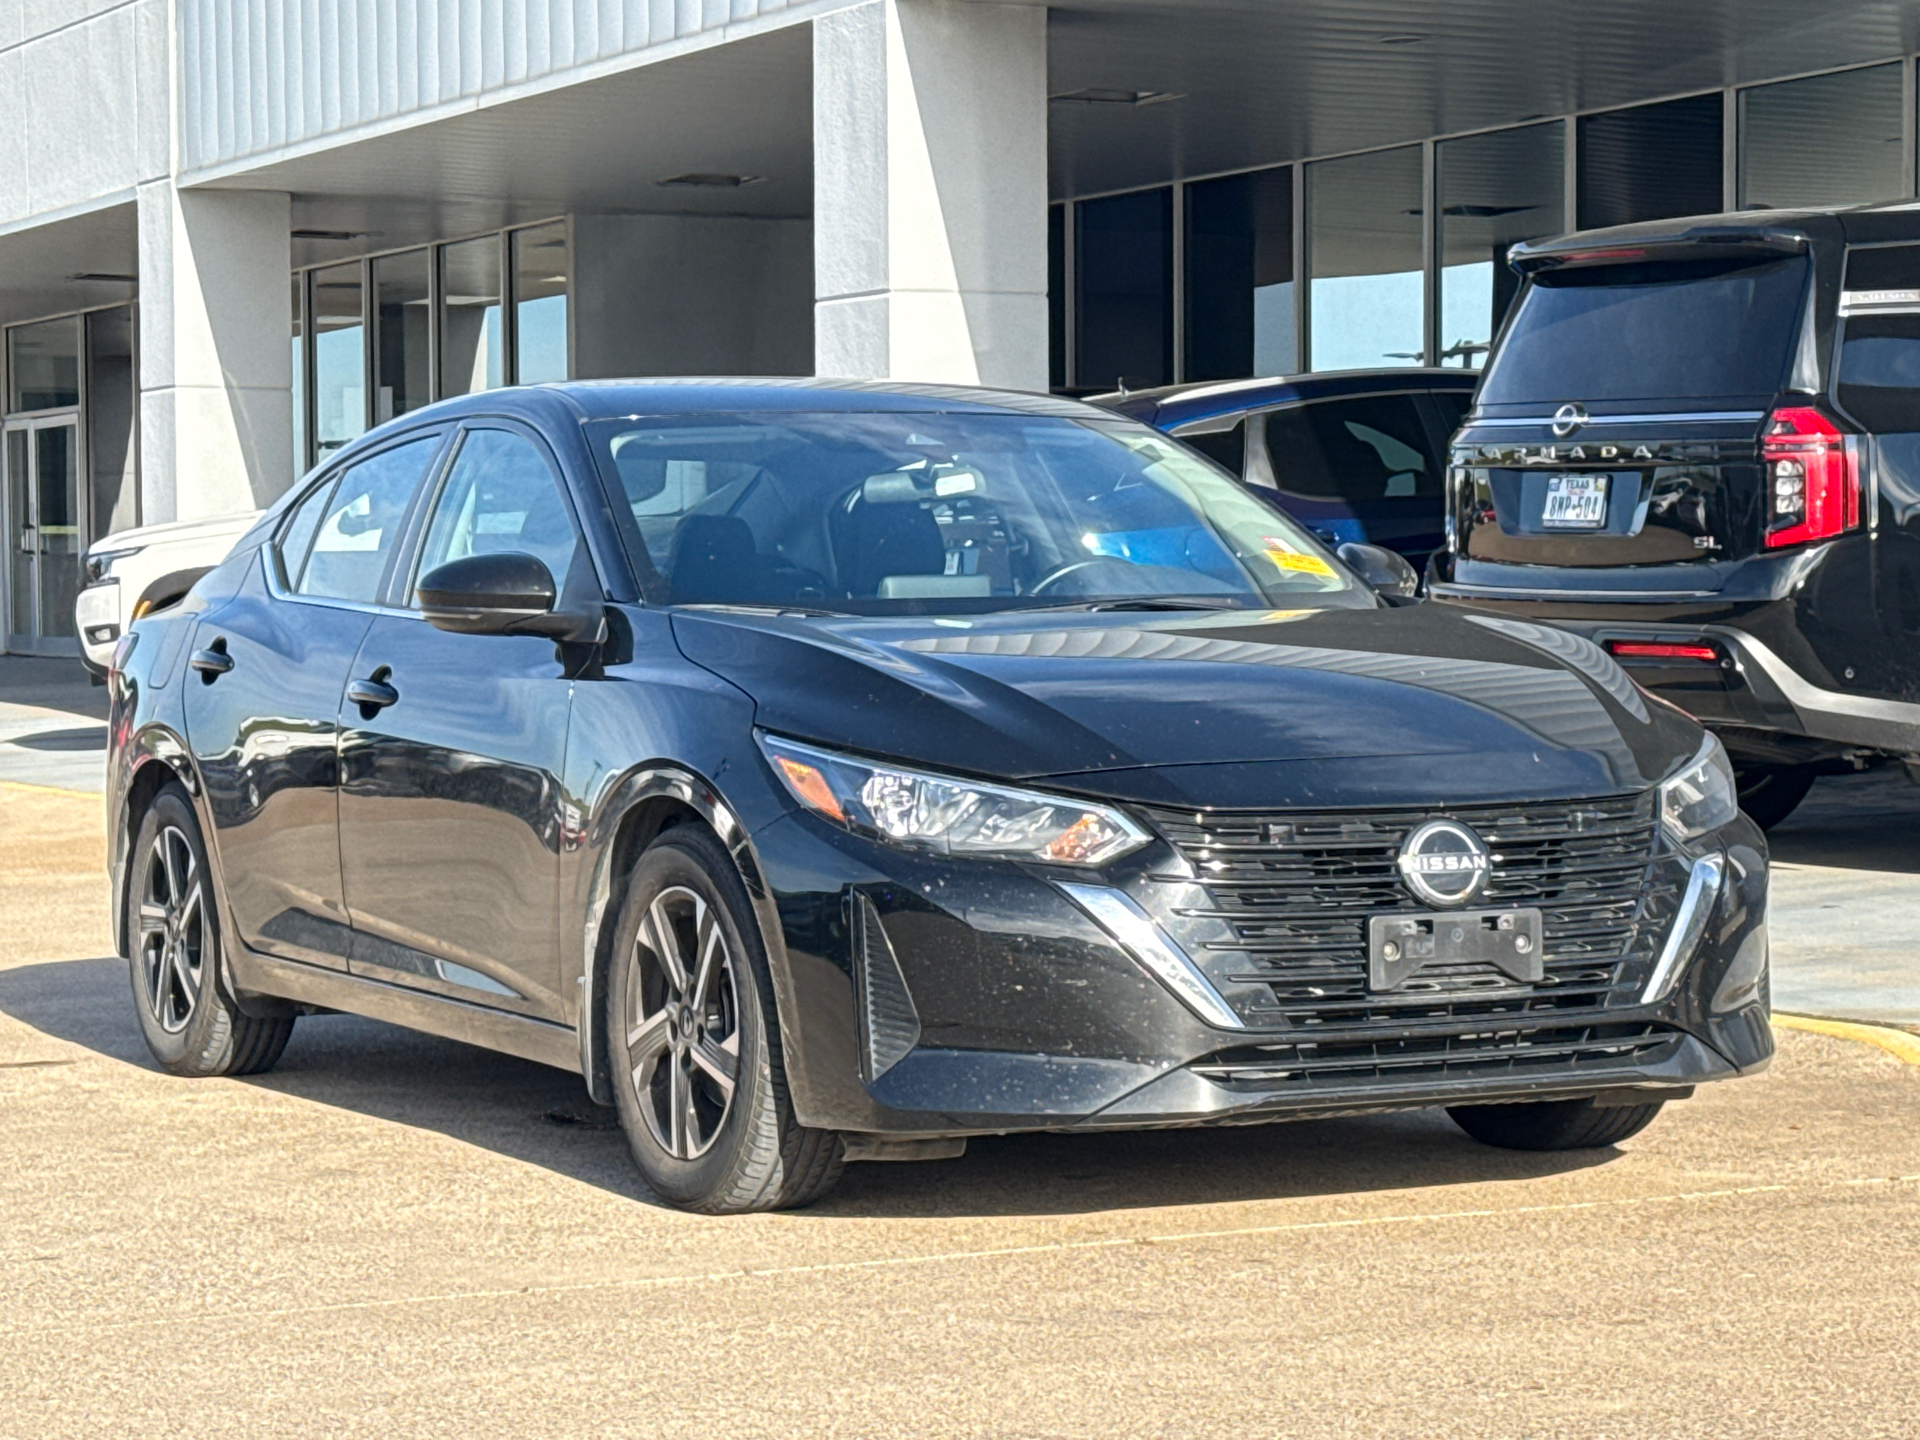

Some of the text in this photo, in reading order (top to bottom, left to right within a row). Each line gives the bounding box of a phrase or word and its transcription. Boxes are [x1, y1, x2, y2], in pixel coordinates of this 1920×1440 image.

[1488, 445, 1652, 460] ARMADA
[1566, 479, 1590, 489] TEXAS
[1693, 536, 1723, 550] SL
[1410, 855, 1487, 871] NISSAN
